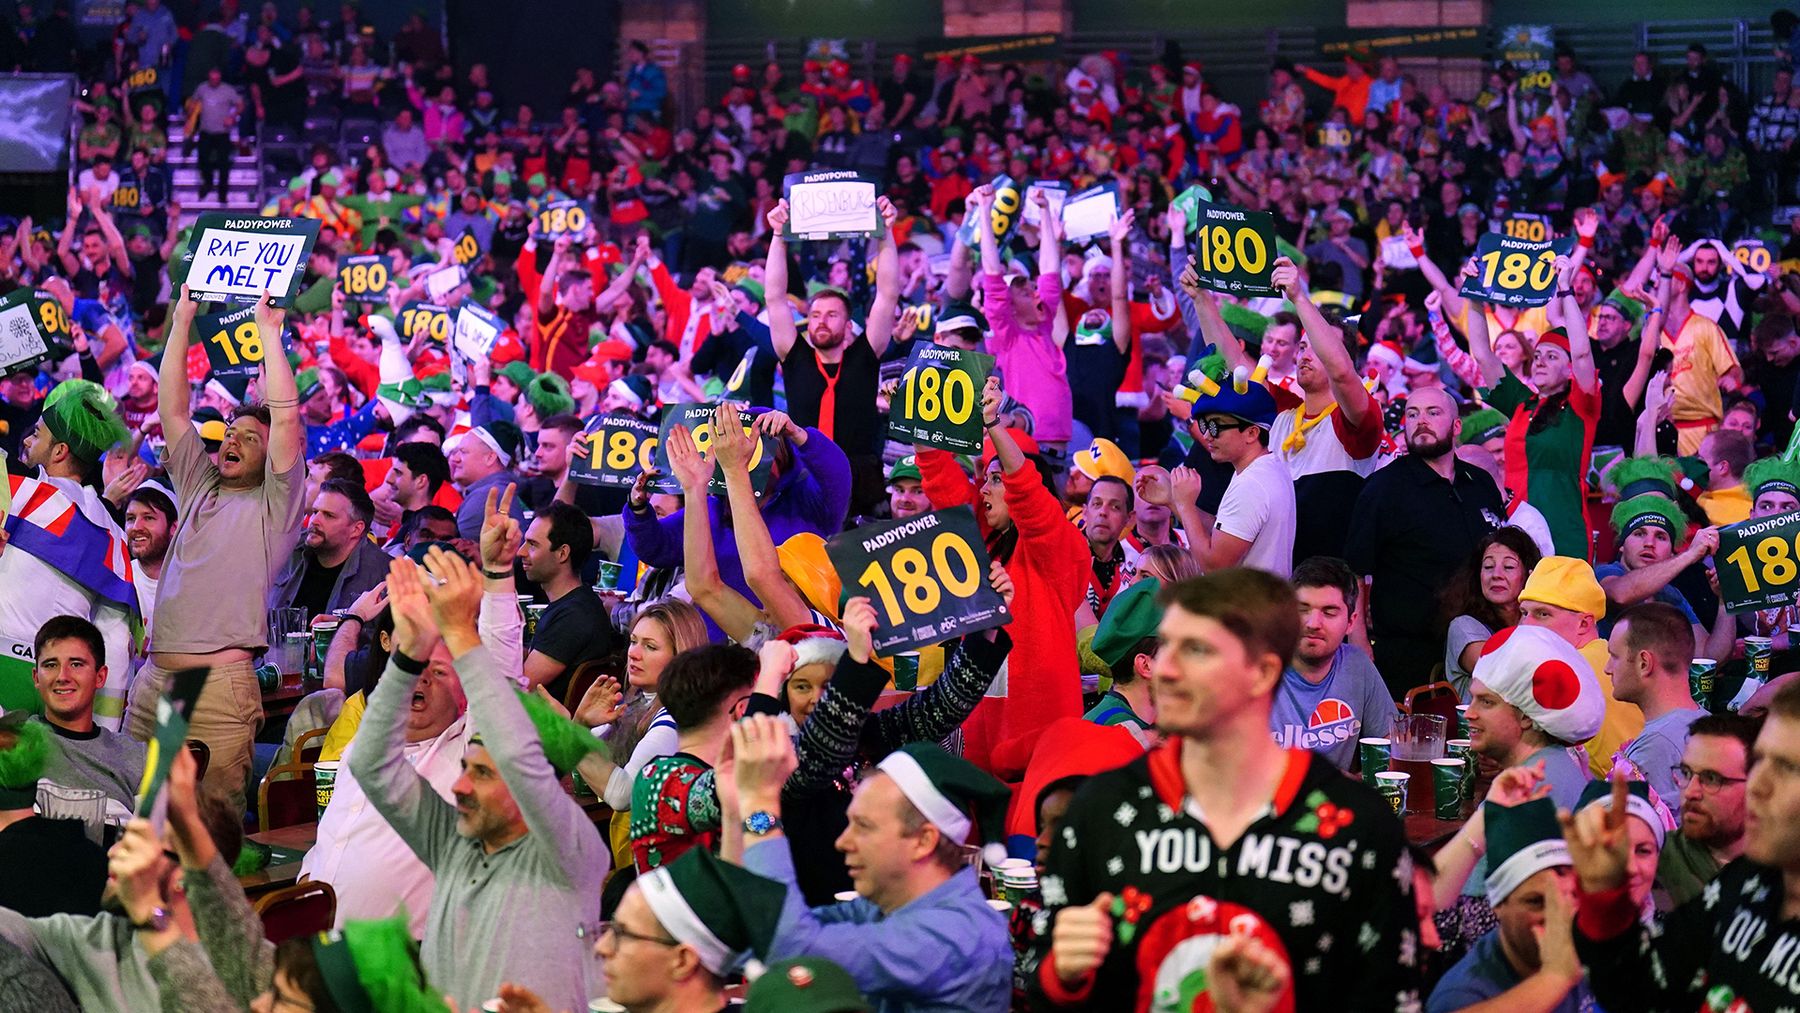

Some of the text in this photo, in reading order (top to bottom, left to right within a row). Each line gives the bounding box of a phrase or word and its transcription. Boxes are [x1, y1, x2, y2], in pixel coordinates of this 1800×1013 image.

[804, 171, 859, 183] PADDYPOWER
[225, 220, 292, 229] PADDYPOWER
[540, 208, 586, 234] 180
[1206, 209, 1246, 221] PADDYPOWER
[1505, 219, 1545, 242] 180
[207, 238, 295, 266] RAF YOU
[1199, 225, 1267, 274] 180
[1501, 240, 1552, 250] PADDYPOWER
[206, 264, 282, 289] MELT
[340, 263, 388, 295] 180
[1482, 250, 1557, 291] 180
[219, 306, 256, 325] PADDYPO
[402, 309, 448, 341] 180
[211, 321, 265, 365] 18
[919, 349, 960, 361] PADDYPOWER
[903, 366, 975, 425] 180
[603, 417, 658, 434] PADDYPOWER
[862, 514, 939, 553] PADDYPOWER
[1738, 512, 1800, 538] PADDYPOWE
[1726, 534, 1800, 593] 18
[858, 531, 981, 627] 180
[1272, 719, 1361, 750] ellesse
[1135, 827, 1353, 895] YOU MISS
